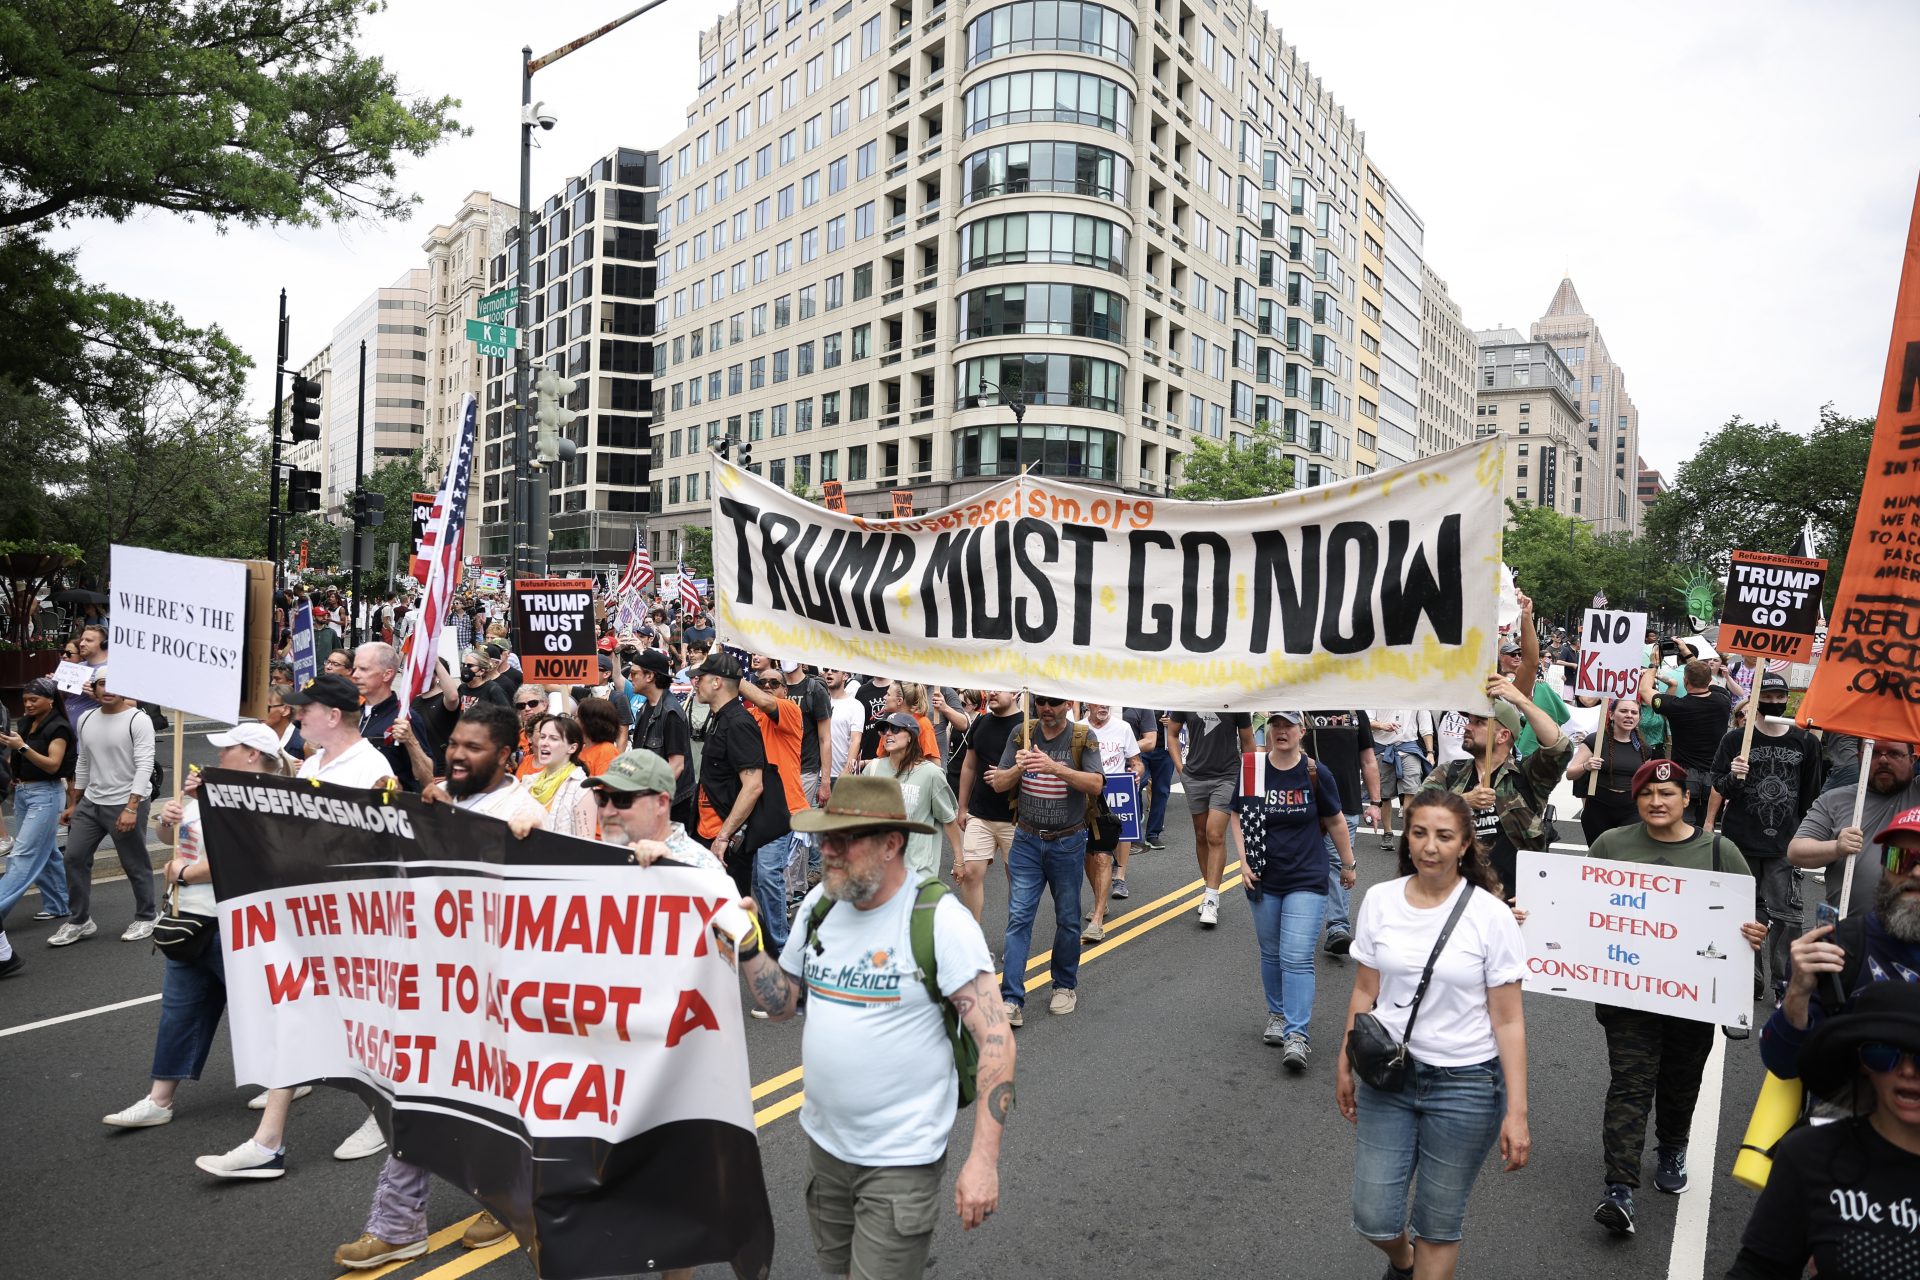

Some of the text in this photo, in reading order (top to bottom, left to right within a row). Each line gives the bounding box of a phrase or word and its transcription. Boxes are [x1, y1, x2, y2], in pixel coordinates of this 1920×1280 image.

[478, 293, 507, 315] Vermont
[488, 310, 505, 323] 1000
[483, 325, 507, 341] K St
[479, 343, 505, 358] 1400
[1547, 451, 1555, 507] HAMILTON
[1882, 460, 1908, 477] IN
[823, 484, 843, 498] TRUMP
[892, 493, 913, 506] TRUMP
[826, 497, 843, 510] MUST
[896, 506, 912, 518] MUST
[1880, 513, 1906, 527] WE
[1869, 530, 1893, 545] TO
[1738, 552, 1820, 568] RefuseFascism.org
[719, 496, 1463, 655] TRUMP MUST GO NOW
[1735, 565, 1821, 590] TRUMP
[520, 593, 591, 612] TRUMP
[1738, 585, 1809, 609] MUST
[200, 607, 235, 632] THE
[529, 614, 585, 632] MUST
[1751, 606, 1787, 627] GO
[1590, 613, 1631, 645] NO
[114, 625, 237, 670] DUE PROCESS?
[544, 634, 573, 652] GO
[1731, 629, 1802, 655] NOW!
[534, 659, 588, 678] NOW!
[1577, 649, 1639, 699] Kings
[1264, 789, 1310, 805] ISSENT
[205, 782, 415, 840] REFUSEFASCISM.ORG
[1581, 864, 1687, 895] PROTECT
[1609, 891, 1647, 910] and
[231, 889, 731, 958] IN THE NAME OF HUMANITY
[1588, 911, 1679, 940] DEFEND
[1607, 943, 1640, 966] the
[837, 964, 901, 990] MEXICO
[1526, 957, 1699, 1002] CONSTITUTION
[264, 955, 331, 1005] WE
[333, 956, 420, 1010] REFUSE
[436, 963, 479, 1014] TO
[665, 988, 720, 1048] A
[1829, 1188, 1920, 1235] We th
